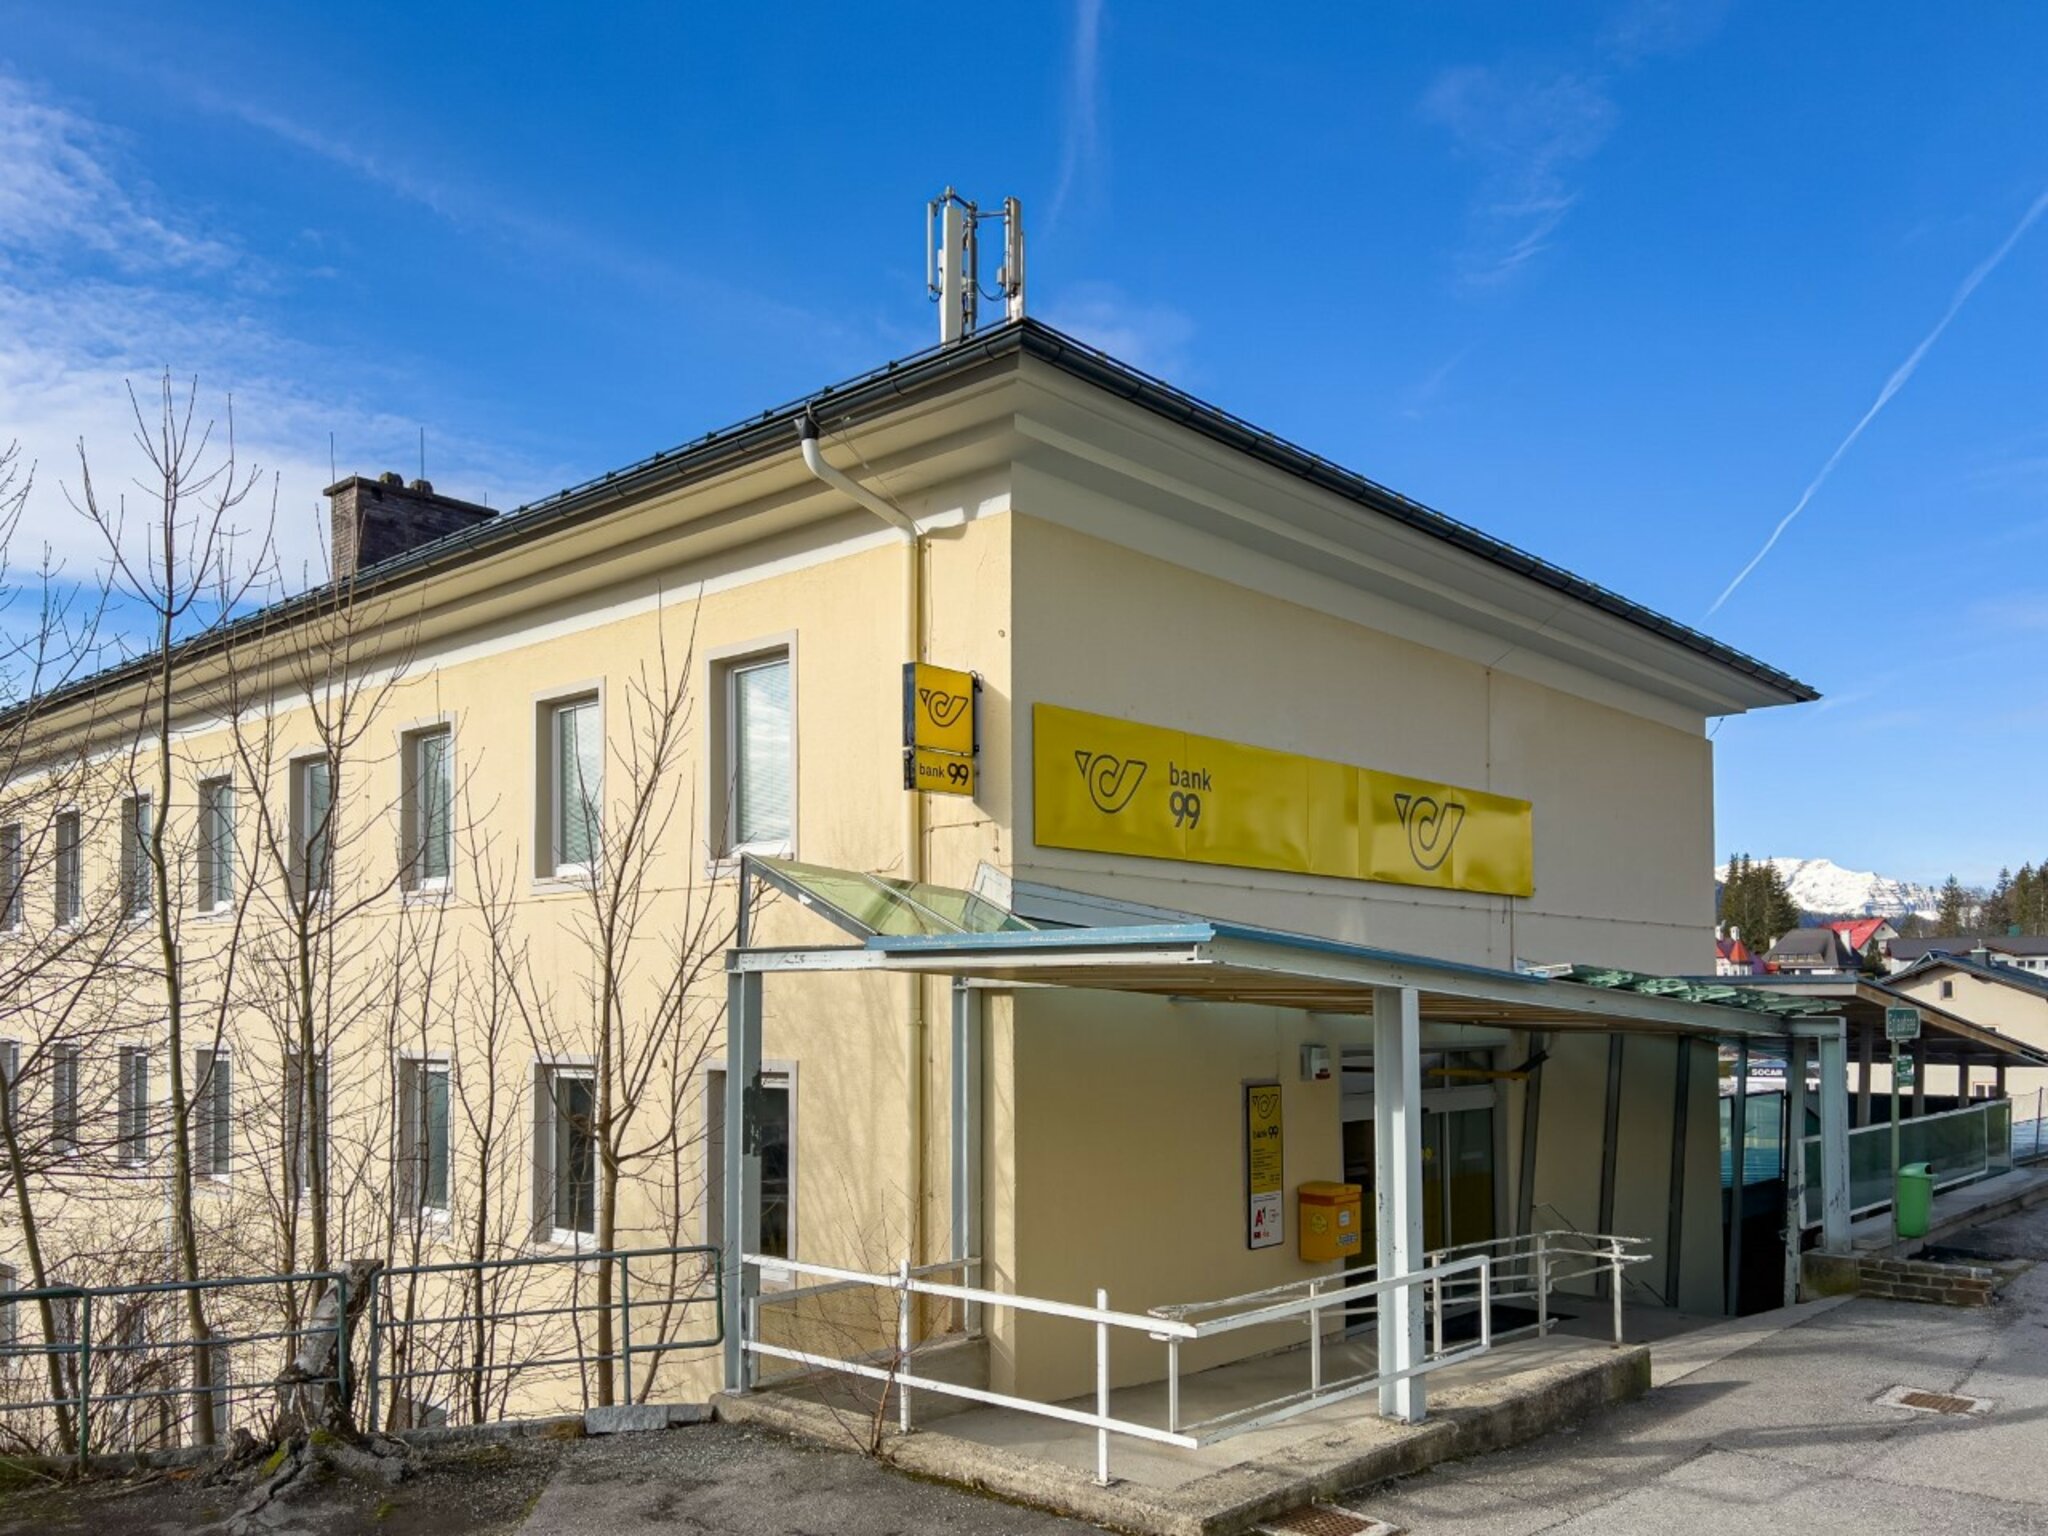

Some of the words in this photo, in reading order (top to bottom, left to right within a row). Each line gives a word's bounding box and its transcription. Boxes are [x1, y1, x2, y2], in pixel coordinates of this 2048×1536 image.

[919, 763, 945, 778] bank
[947, 762, 970, 786] 99
[1169, 761, 1212, 792] bank
[1169, 791, 1201, 830] 99
[1751, 1068, 1783, 1076] SOCAR
